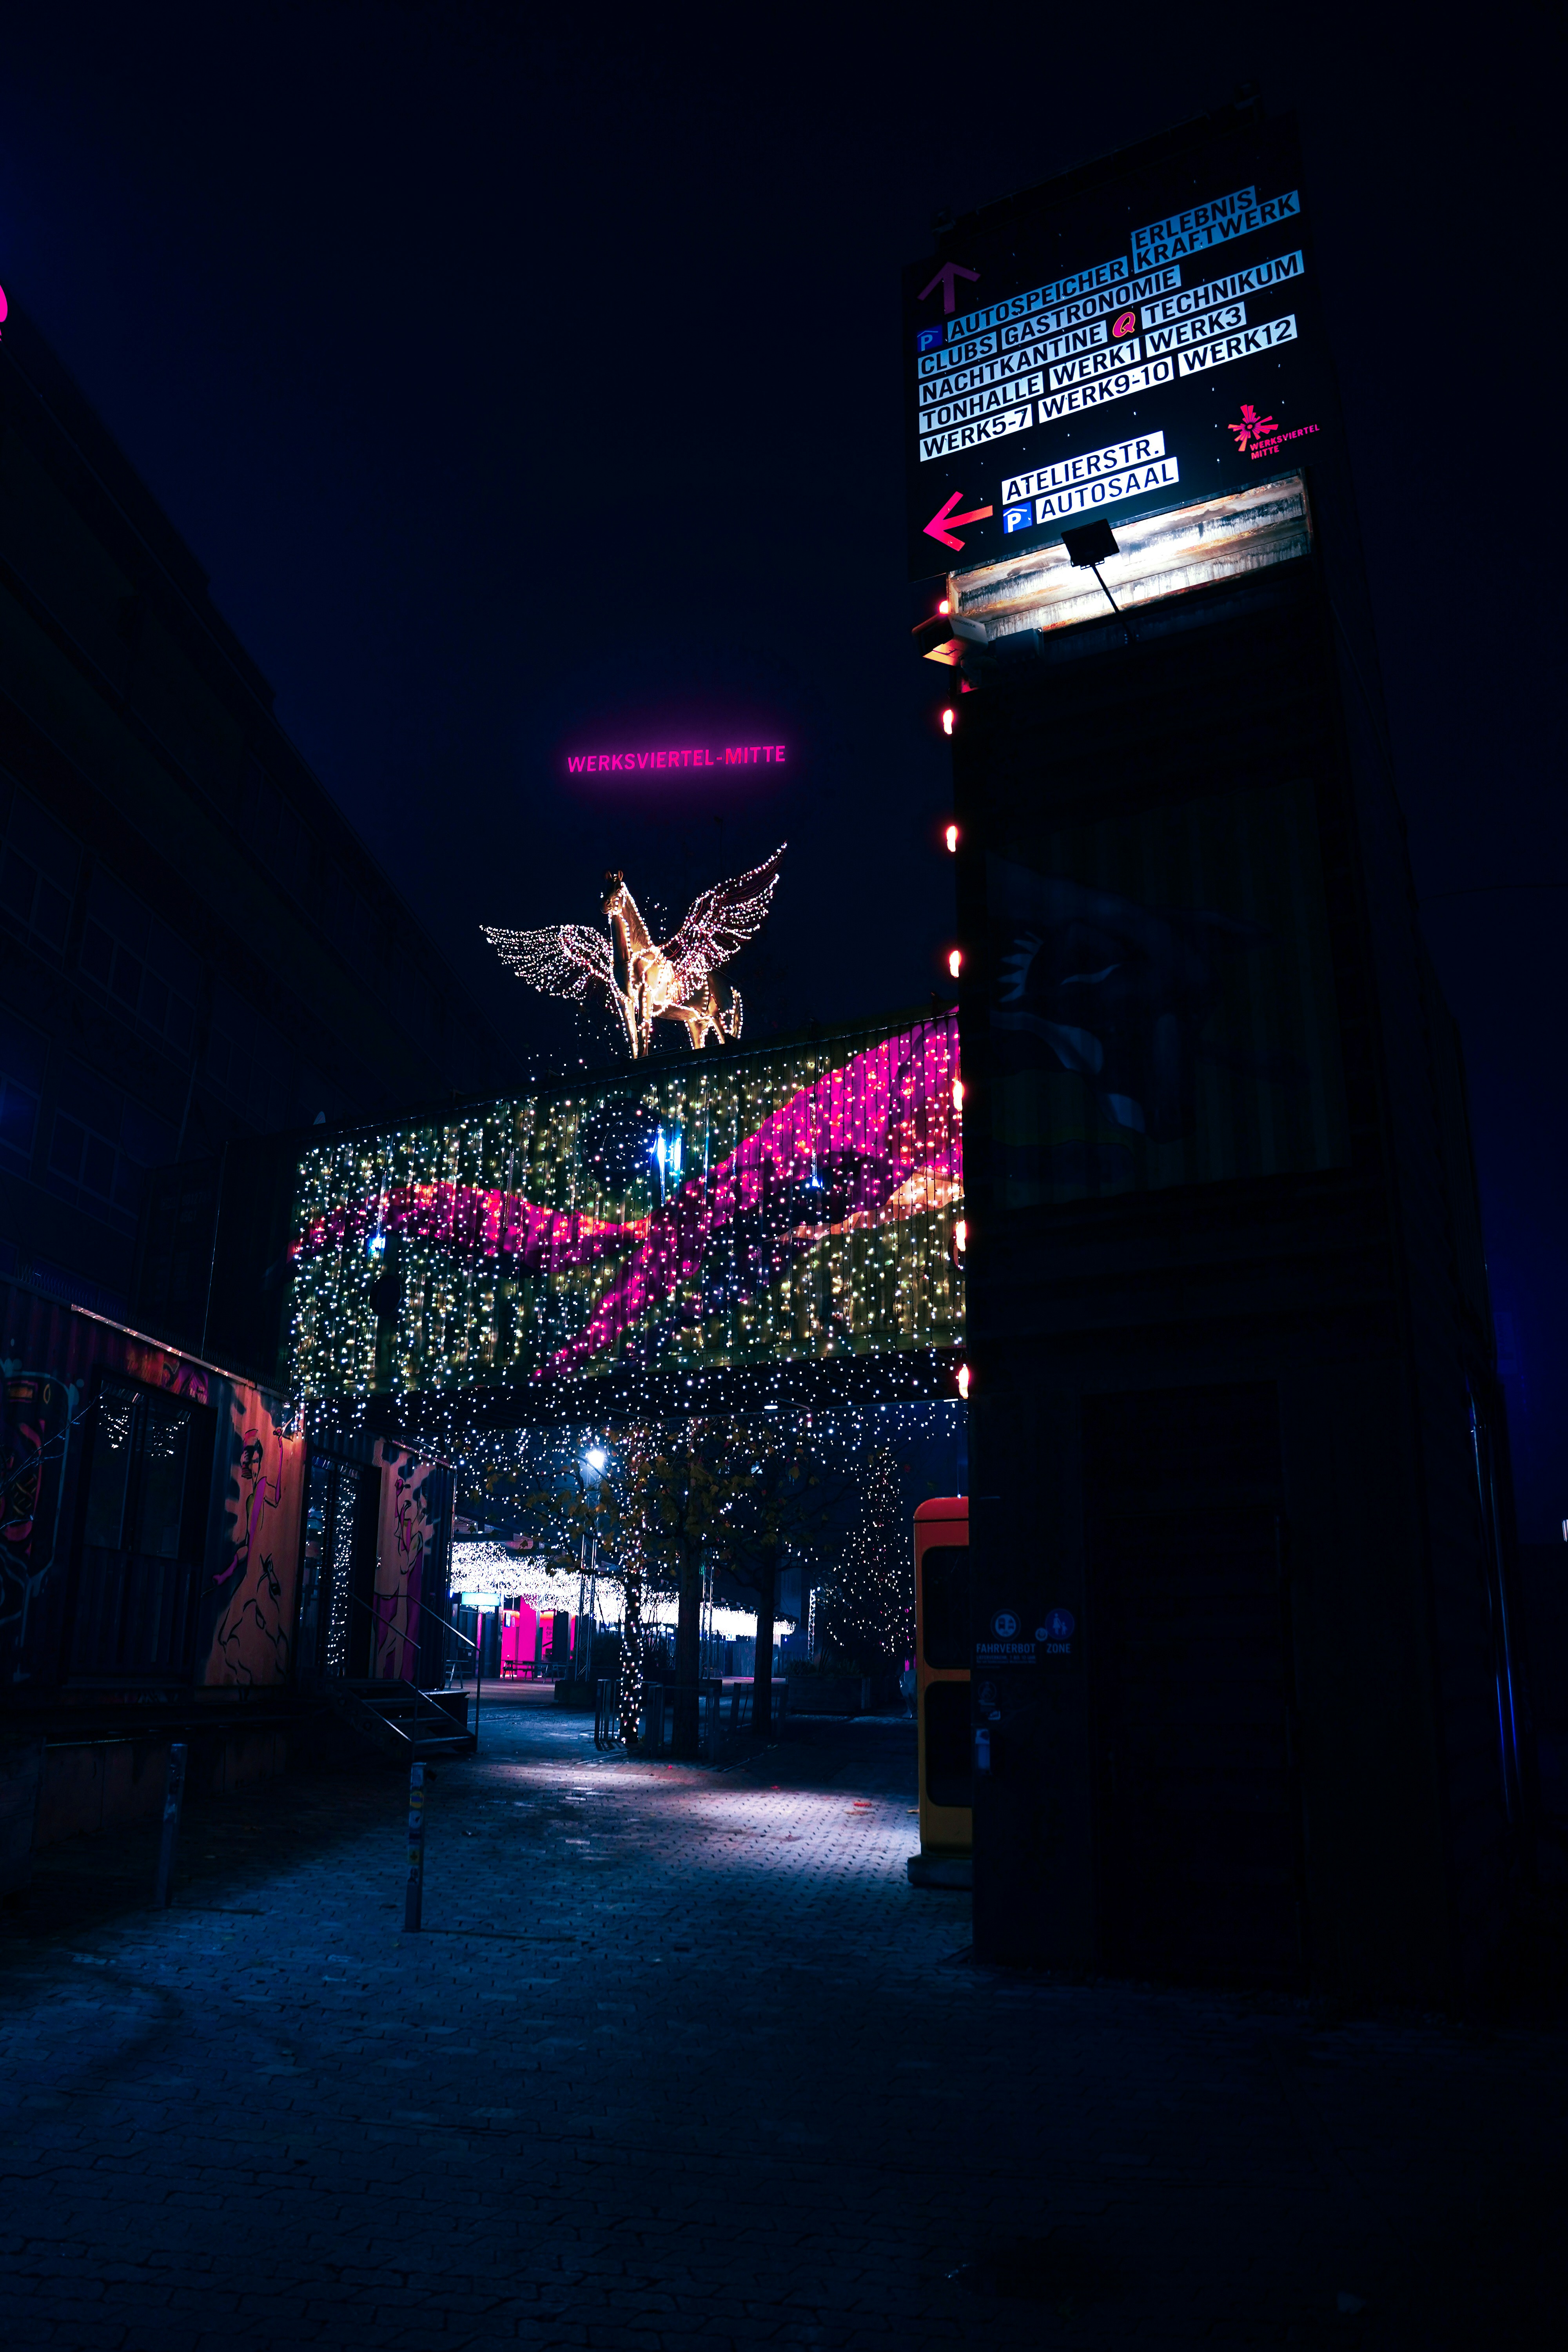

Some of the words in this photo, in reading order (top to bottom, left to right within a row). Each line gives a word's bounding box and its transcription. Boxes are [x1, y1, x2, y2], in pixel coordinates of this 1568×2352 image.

[1136, 191, 1253, 249] ERLEBNIS
[1137, 194, 1296, 270] KRAFTWERK
[921, 334, 933, 351] P
[951, 261, 1124, 339] AUTOSPEICHER
[921, 336, 993, 374] CLUBS
[1004, 268, 1176, 345] GASTRONOMIE
[923, 324, 1102, 403] NACHTKANTINE
[1145, 254, 1298, 324] TECHNIKUM
[922, 375, 1040, 430] TONHALLE
[1053, 342, 1137, 386] WERK1
[1149, 306, 1241, 352] WERK3
[923, 407, 1028, 458] WERK5-7
[1042, 361, 1169, 418] WERK9-10
[1183, 319, 1292, 371] WERK12
[1007, 439, 1159, 500] ATELIERSTR.
[1250, 424, 1320, 451] WERKSVIERTEL
[1251, 445, 1279, 459] MITTE
[1007, 512, 1021, 532] P
[1041, 463, 1174, 519] AUTOSAAL
[976, 1643, 1035, 1653] FAHRVERBOT
[1047, 1643, 1071, 1653] ZONE
